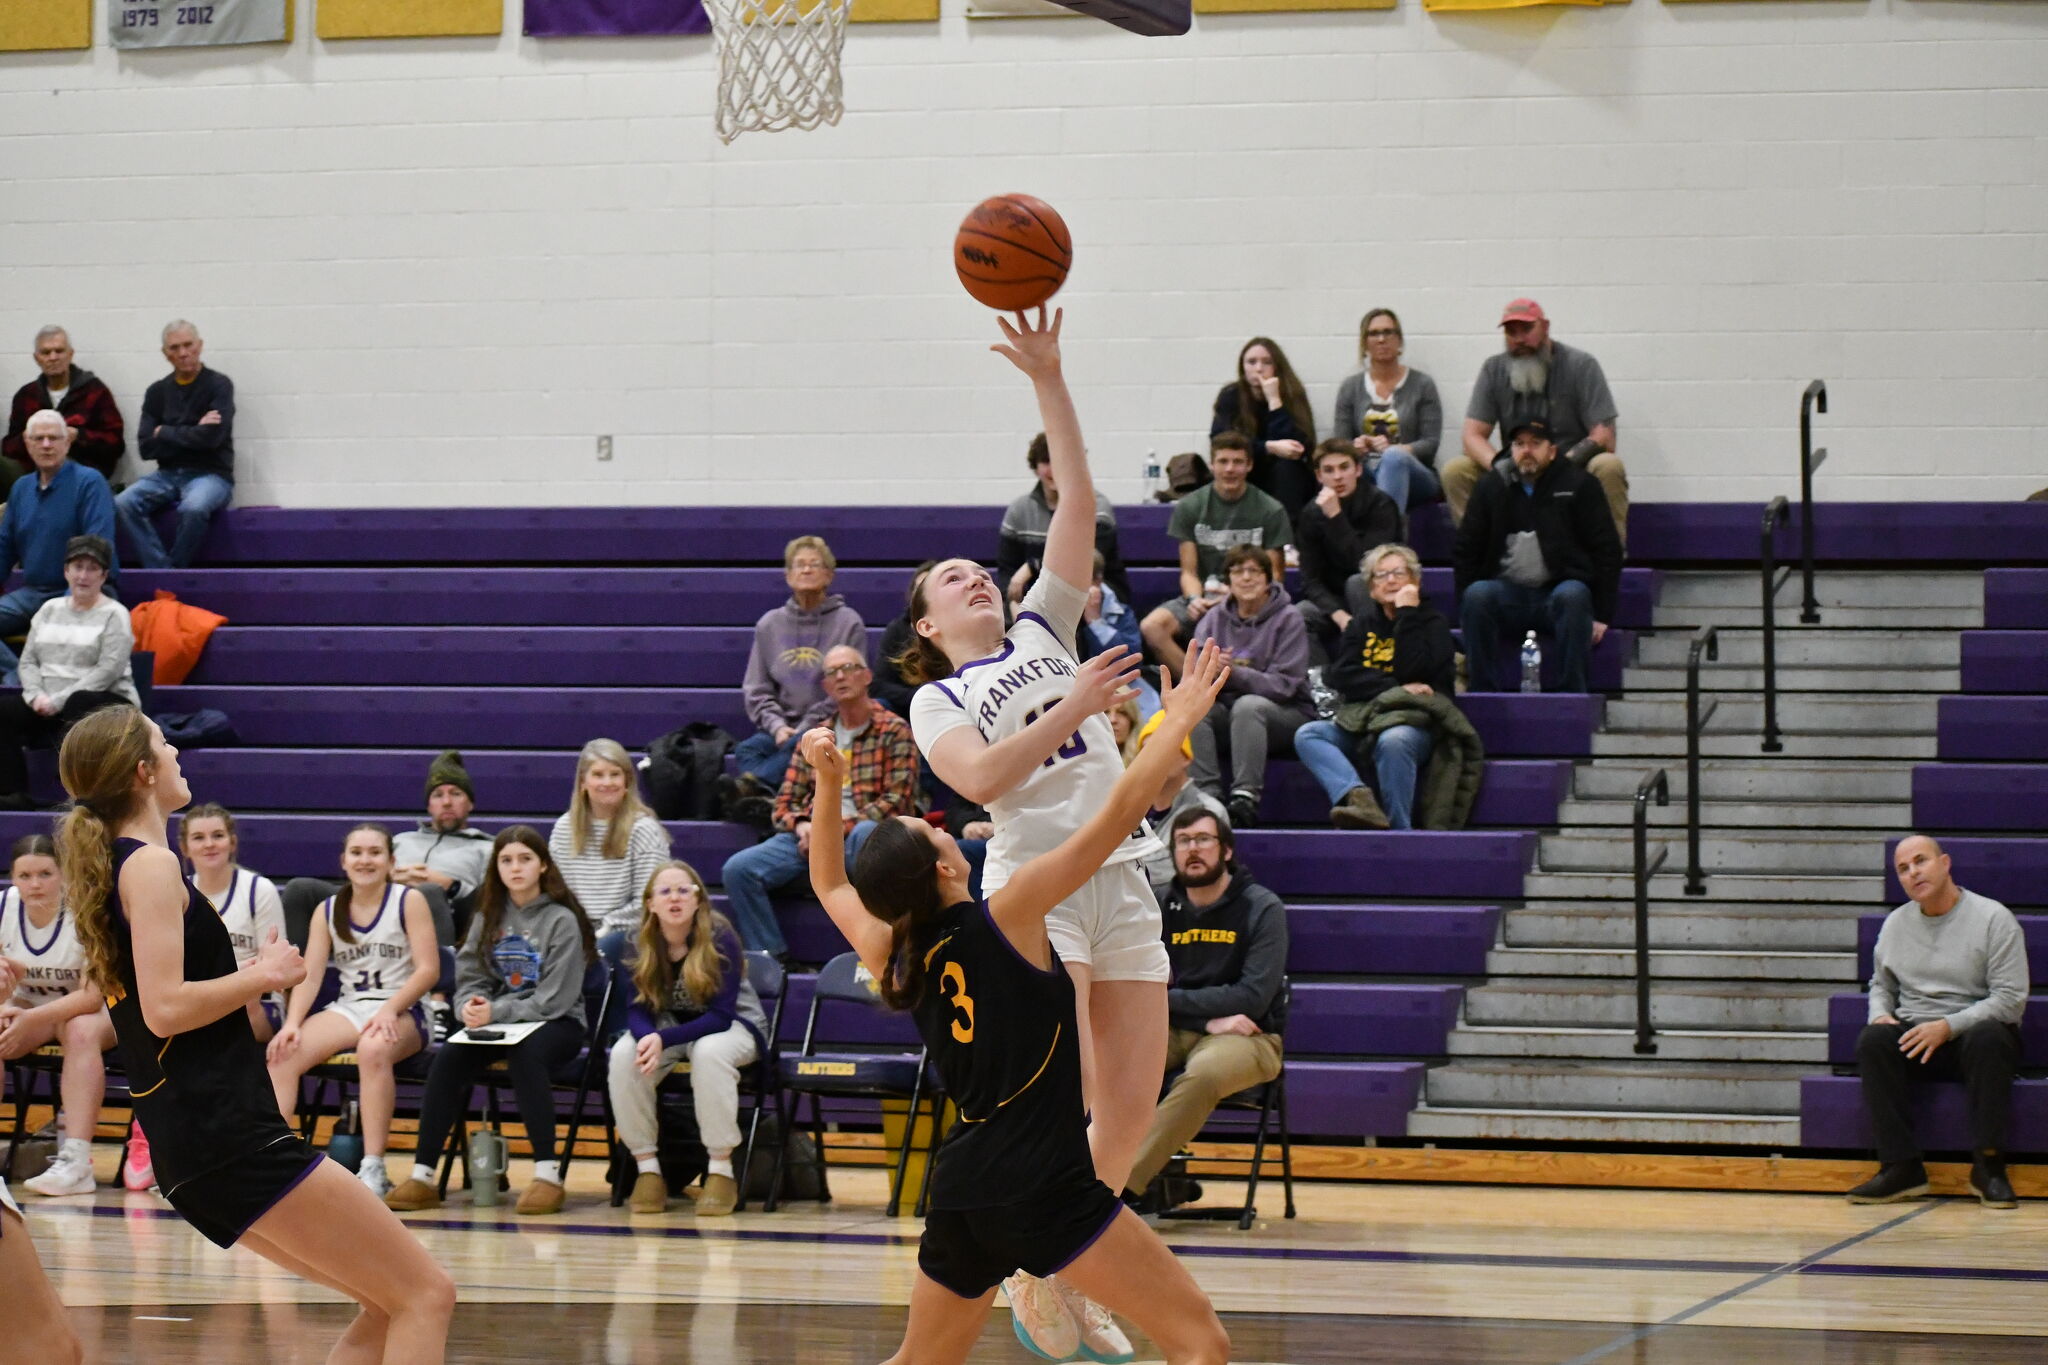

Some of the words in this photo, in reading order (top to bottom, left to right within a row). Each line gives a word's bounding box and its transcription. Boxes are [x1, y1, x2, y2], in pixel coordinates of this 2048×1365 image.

[122, 8, 159, 27] 1979
[176, 6, 214, 25] 2012
[353, 970, 384, 992] 21
[939, 961, 975, 1044] 3
